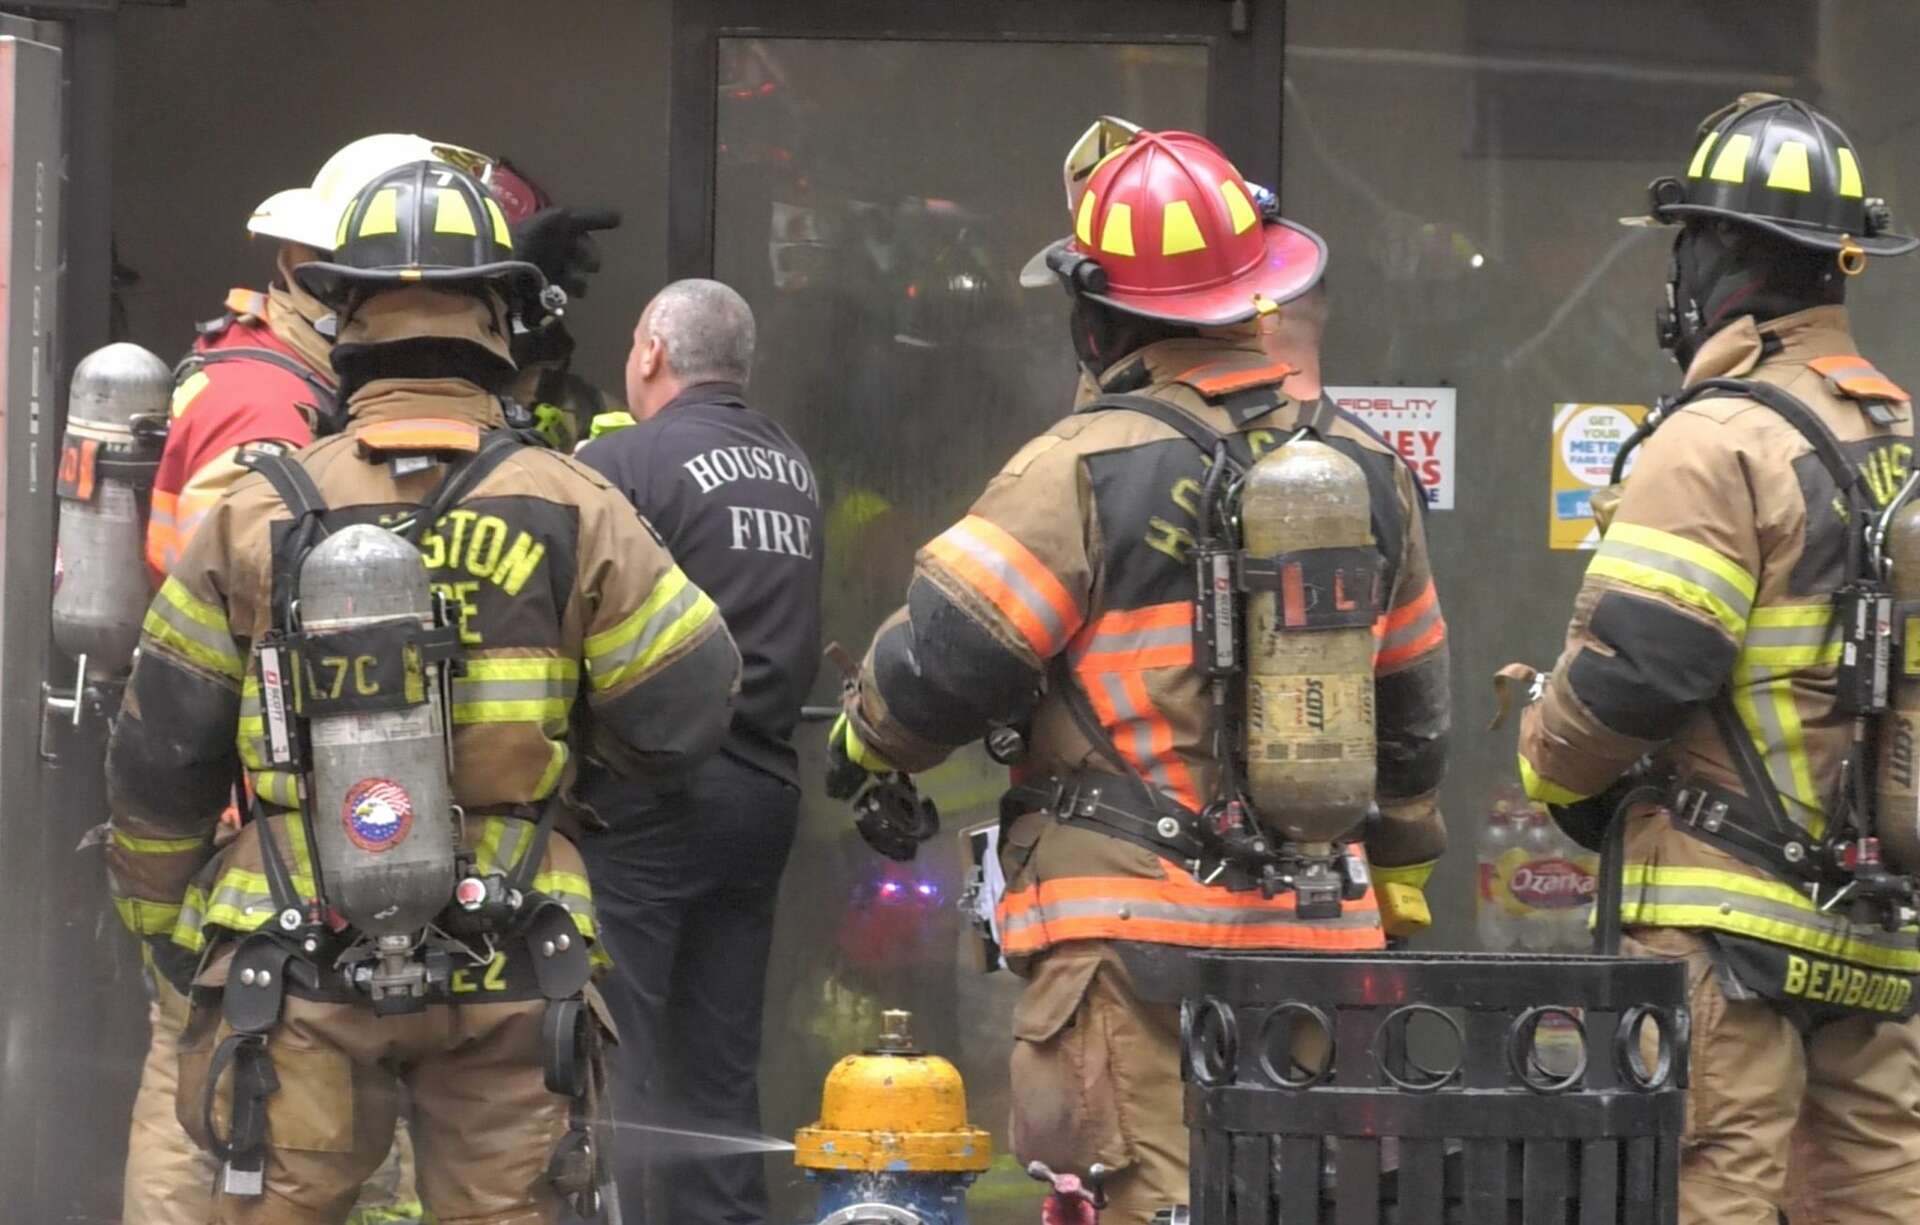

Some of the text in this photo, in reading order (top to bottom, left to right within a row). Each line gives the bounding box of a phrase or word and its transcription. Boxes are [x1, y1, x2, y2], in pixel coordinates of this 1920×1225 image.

[1337, 398, 1438, 411] FIDELITY
[1588, 416, 1615, 426] GET
[1584, 429, 1621, 439] YOUR
[1570, 441, 1621, 453] METR
[728, 506, 813, 560] FIRE
[420, 510, 545, 597] STON
[1306, 678, 1324, 732] SCOTT
[1511, 867, 1597, 895] Ozarka
